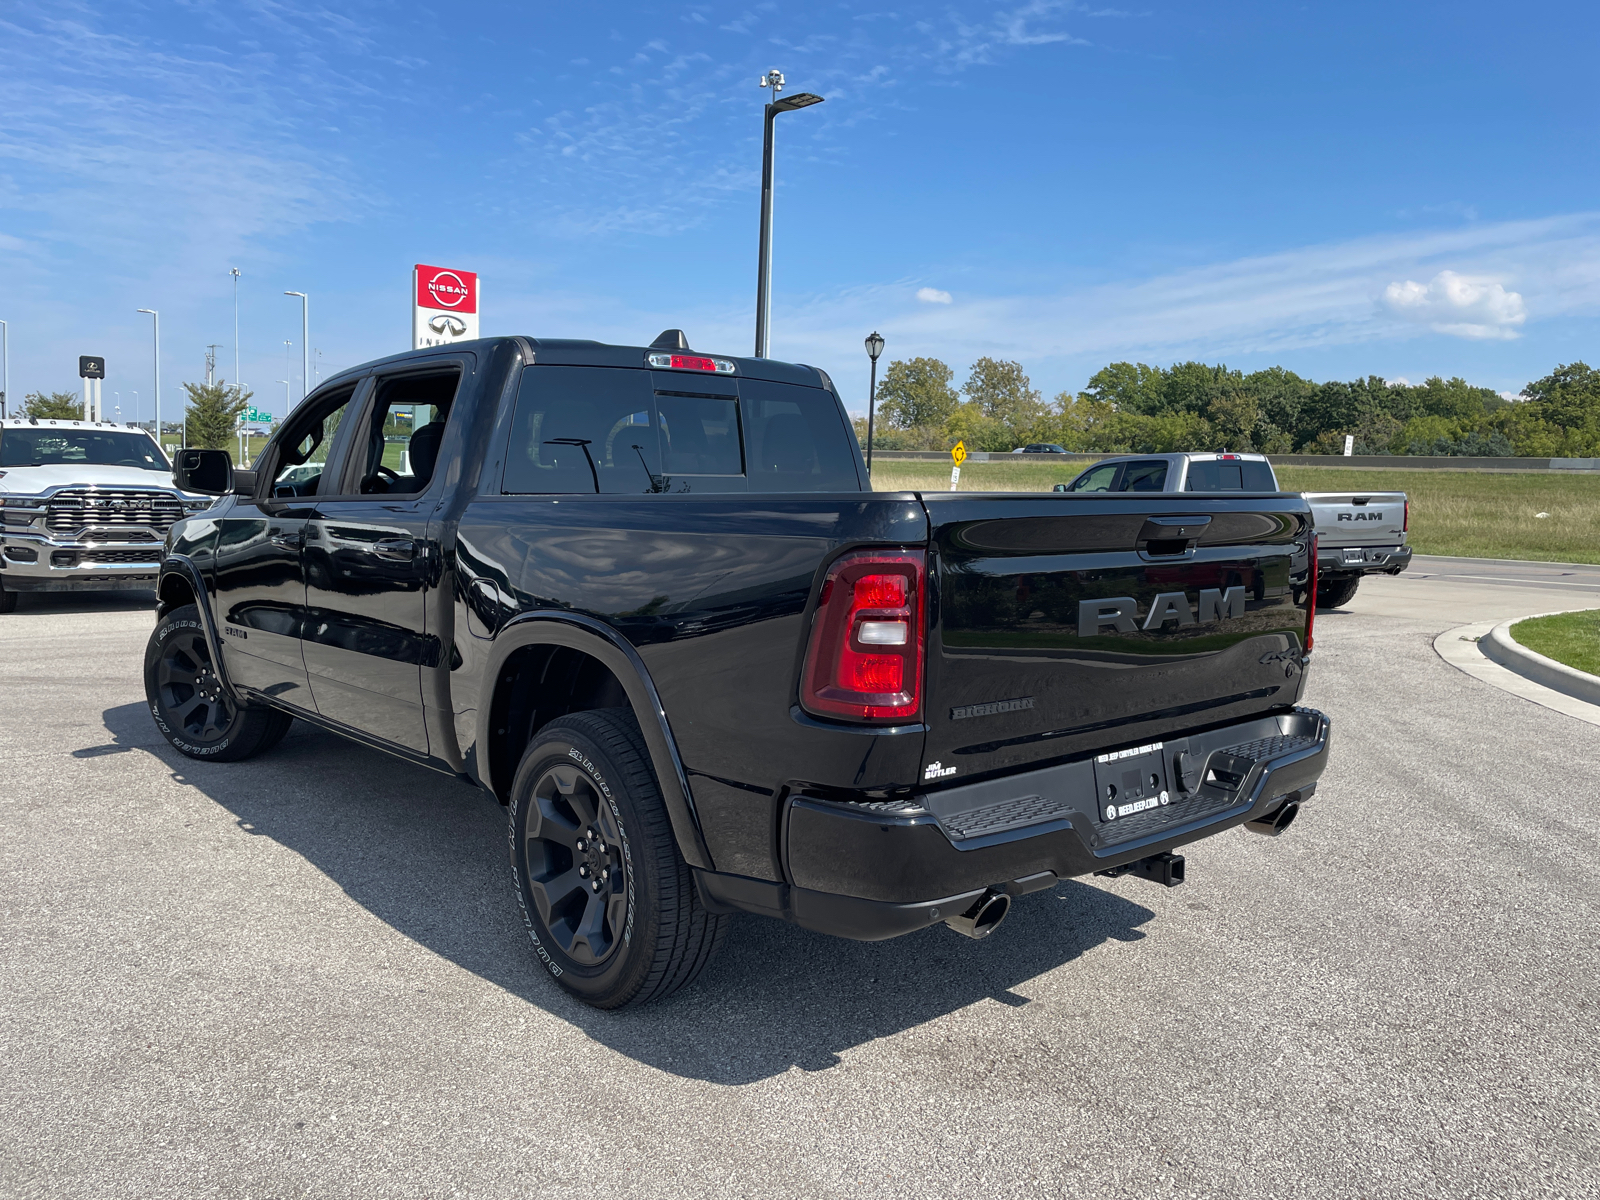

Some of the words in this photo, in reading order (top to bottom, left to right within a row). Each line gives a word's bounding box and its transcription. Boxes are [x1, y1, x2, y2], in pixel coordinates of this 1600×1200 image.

[428, 283, 468, 295] NISSAN
[1337, 512, 1383, 521] RAM
[1077, 585, 1246, 637] RAM
[225, 626, 247, 639] RAM
[173, 738, 229, 755] DUELER
[924, 766, 957, 780] BUTLER
[925, 763, 941, 771] JIM
[568, 747, 635, 948] BRIDGESTONE
